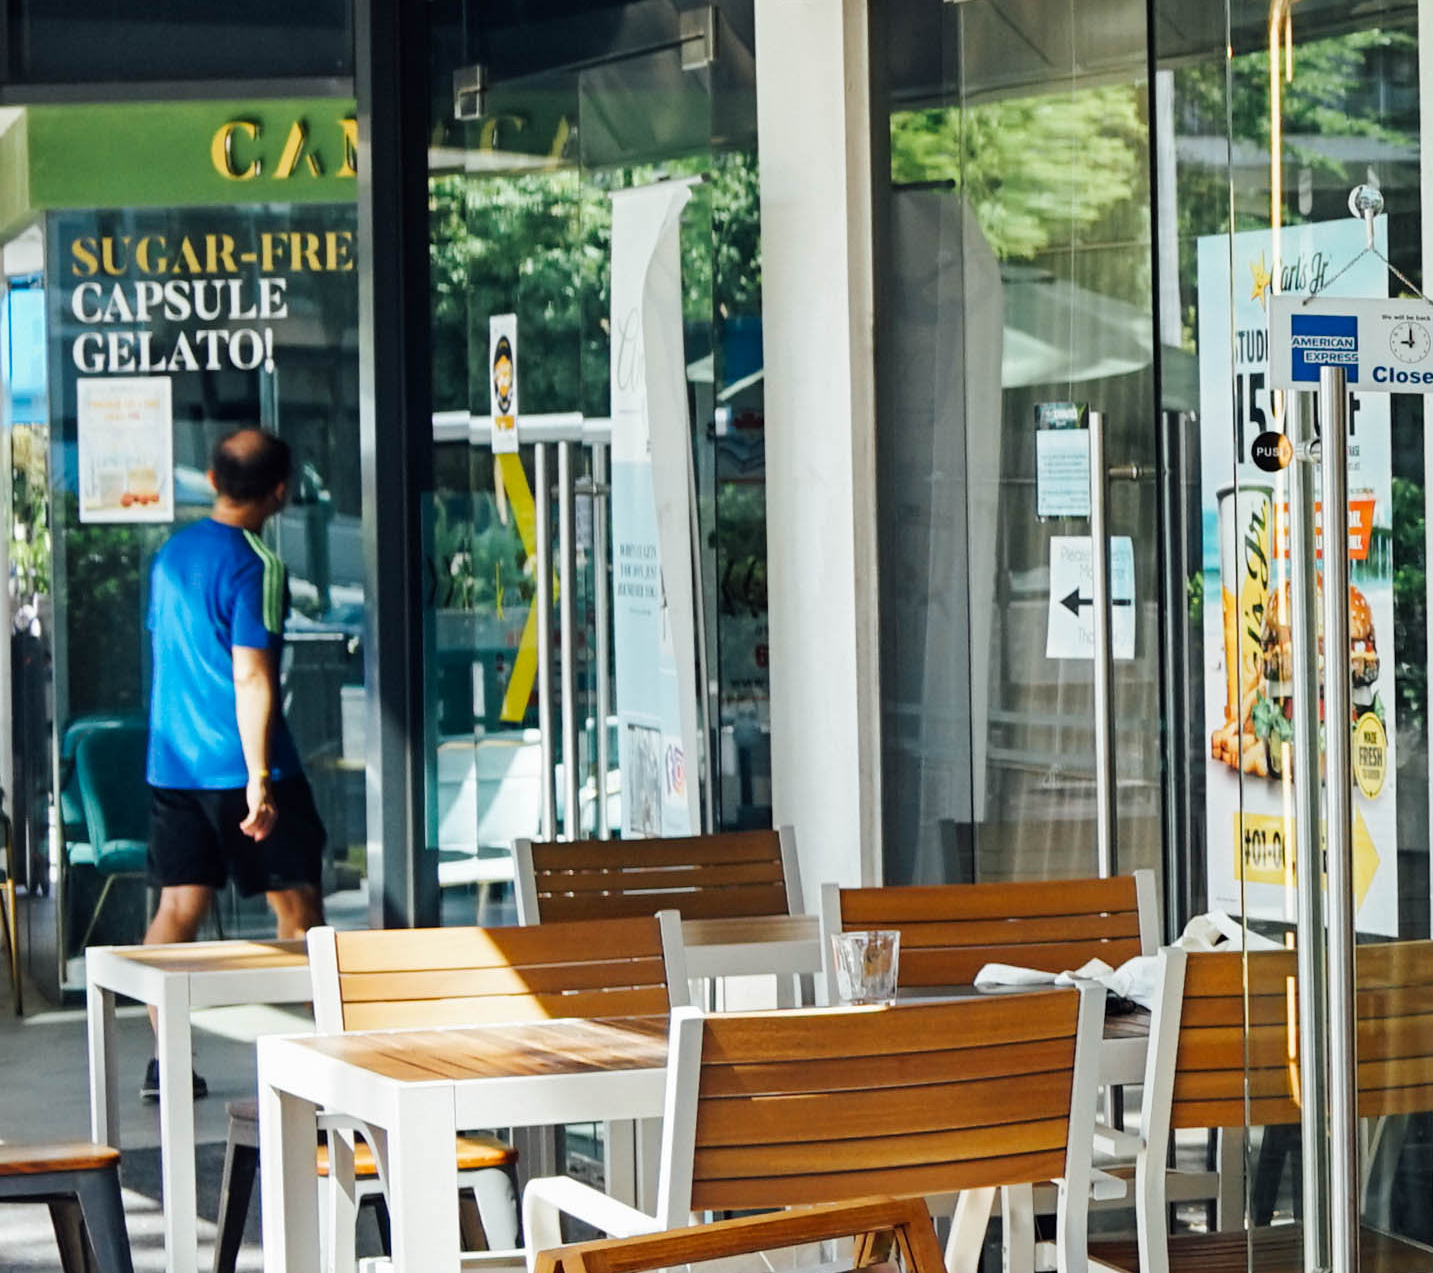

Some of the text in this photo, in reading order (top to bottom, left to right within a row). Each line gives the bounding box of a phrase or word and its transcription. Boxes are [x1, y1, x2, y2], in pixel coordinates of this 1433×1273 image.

[70, 230, 357, 277] SUGAR-FRE
[71, 277, 289, 324] CAPSULE
[71, 329, 276, 375] GELATO!
[1292, 336, 1354, 349] AMERICAN
[1304, 351, 1358, 363] EXPRESS
[1359, 747, 1382, 767] FRESH
